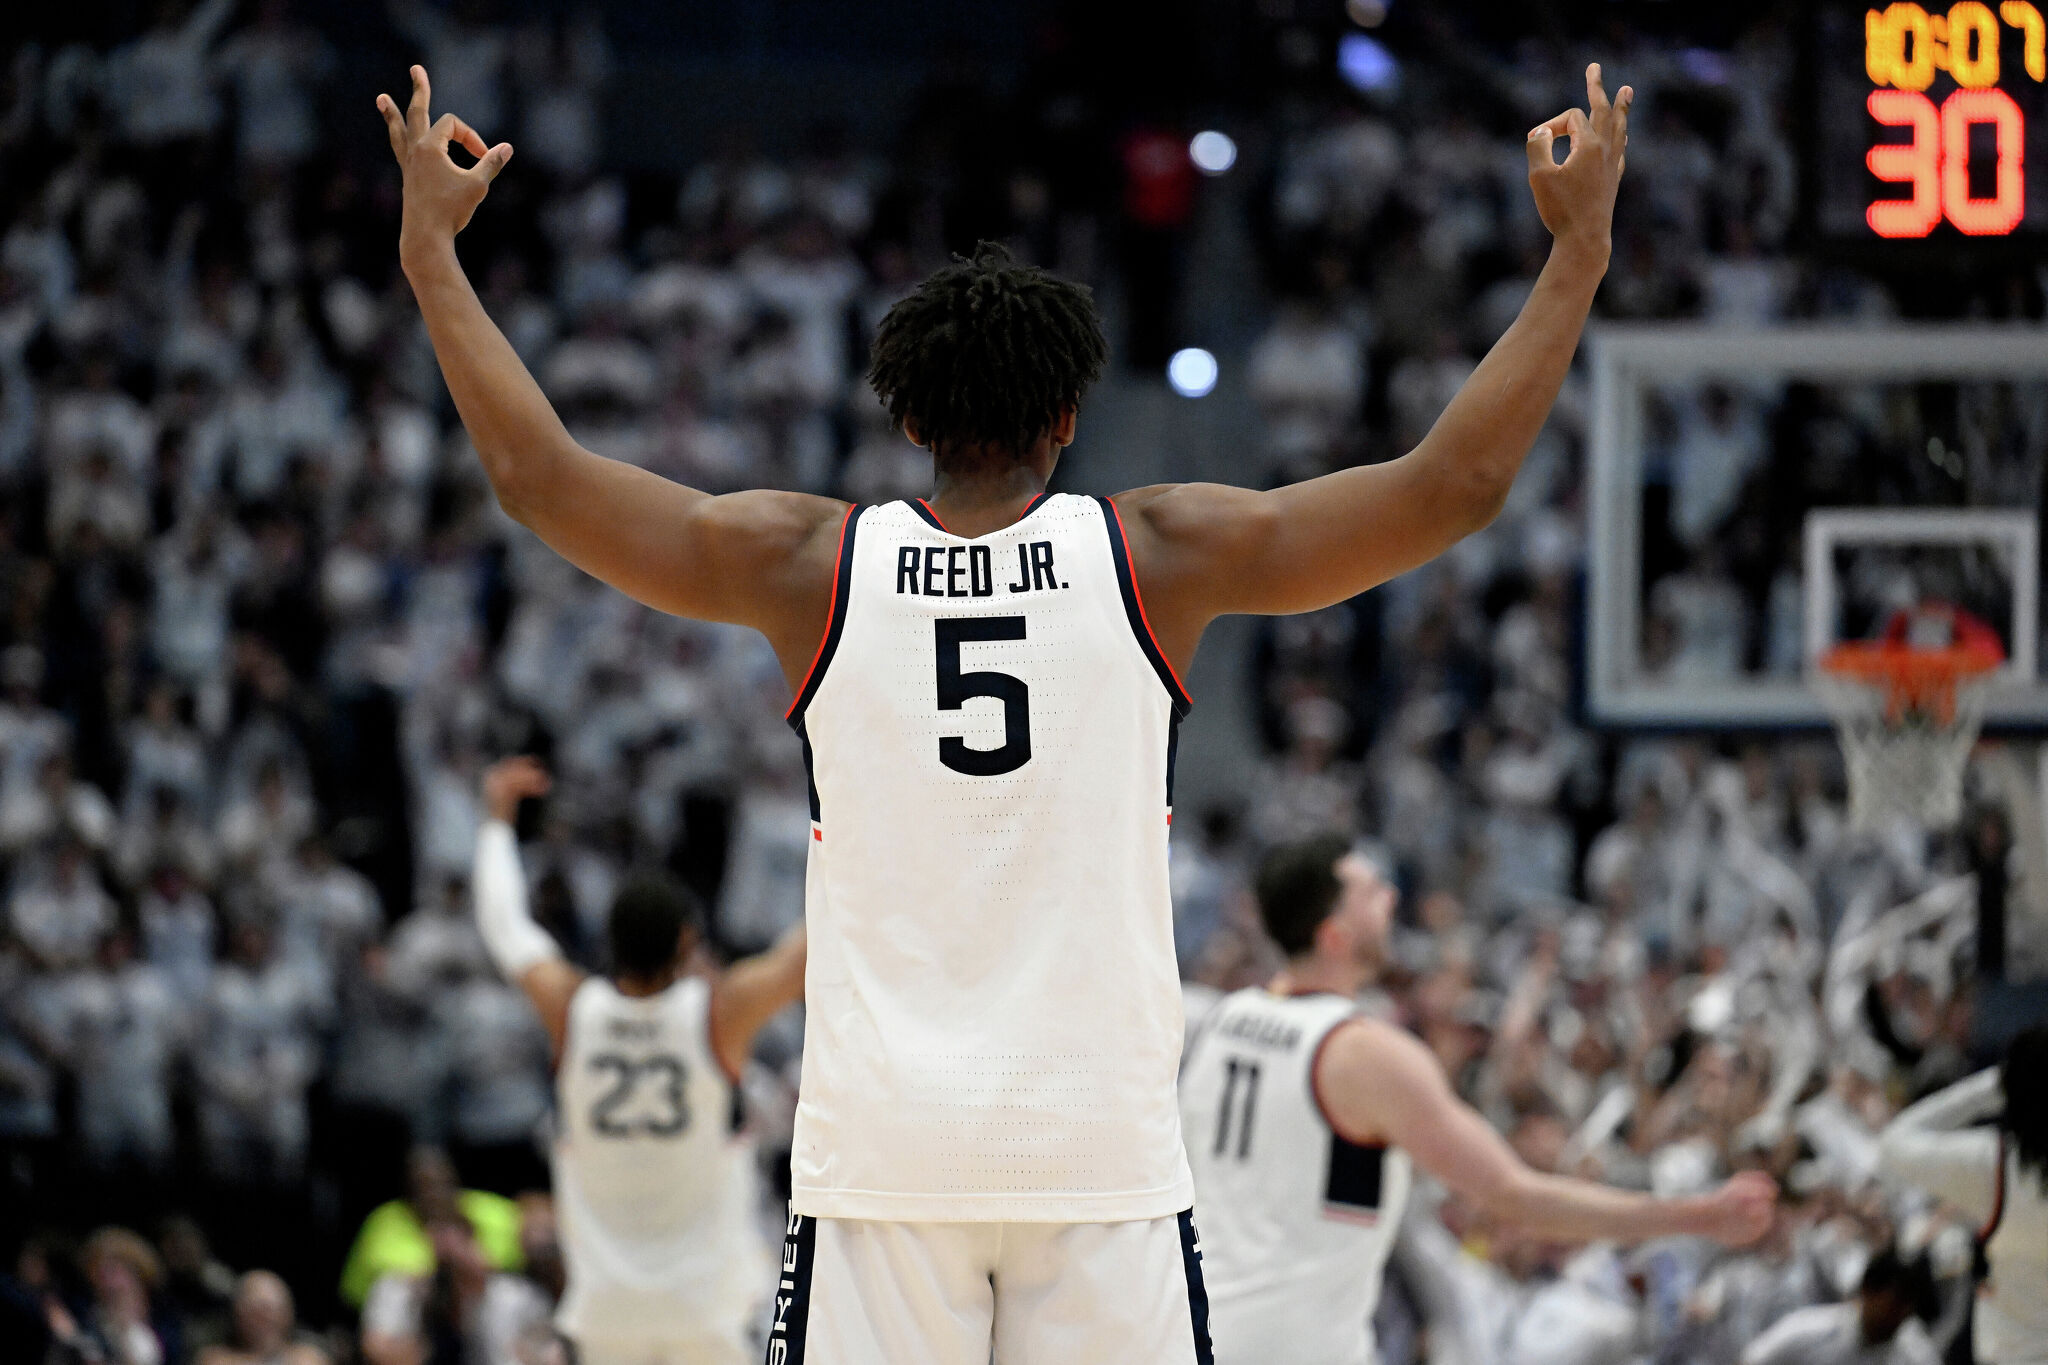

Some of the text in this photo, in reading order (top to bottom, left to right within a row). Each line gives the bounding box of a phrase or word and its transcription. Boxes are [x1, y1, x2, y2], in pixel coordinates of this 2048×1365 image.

[1866, 0, 2046, 92] 10:07
[1866, 88, 2024, 238] 30
[896, 541, 1069, 598] REED JR.
[934, 615, 1031, 776] 5
[588, 1053, 691, 1137] 23
[1213, 1057, 1260, 1160] 11
